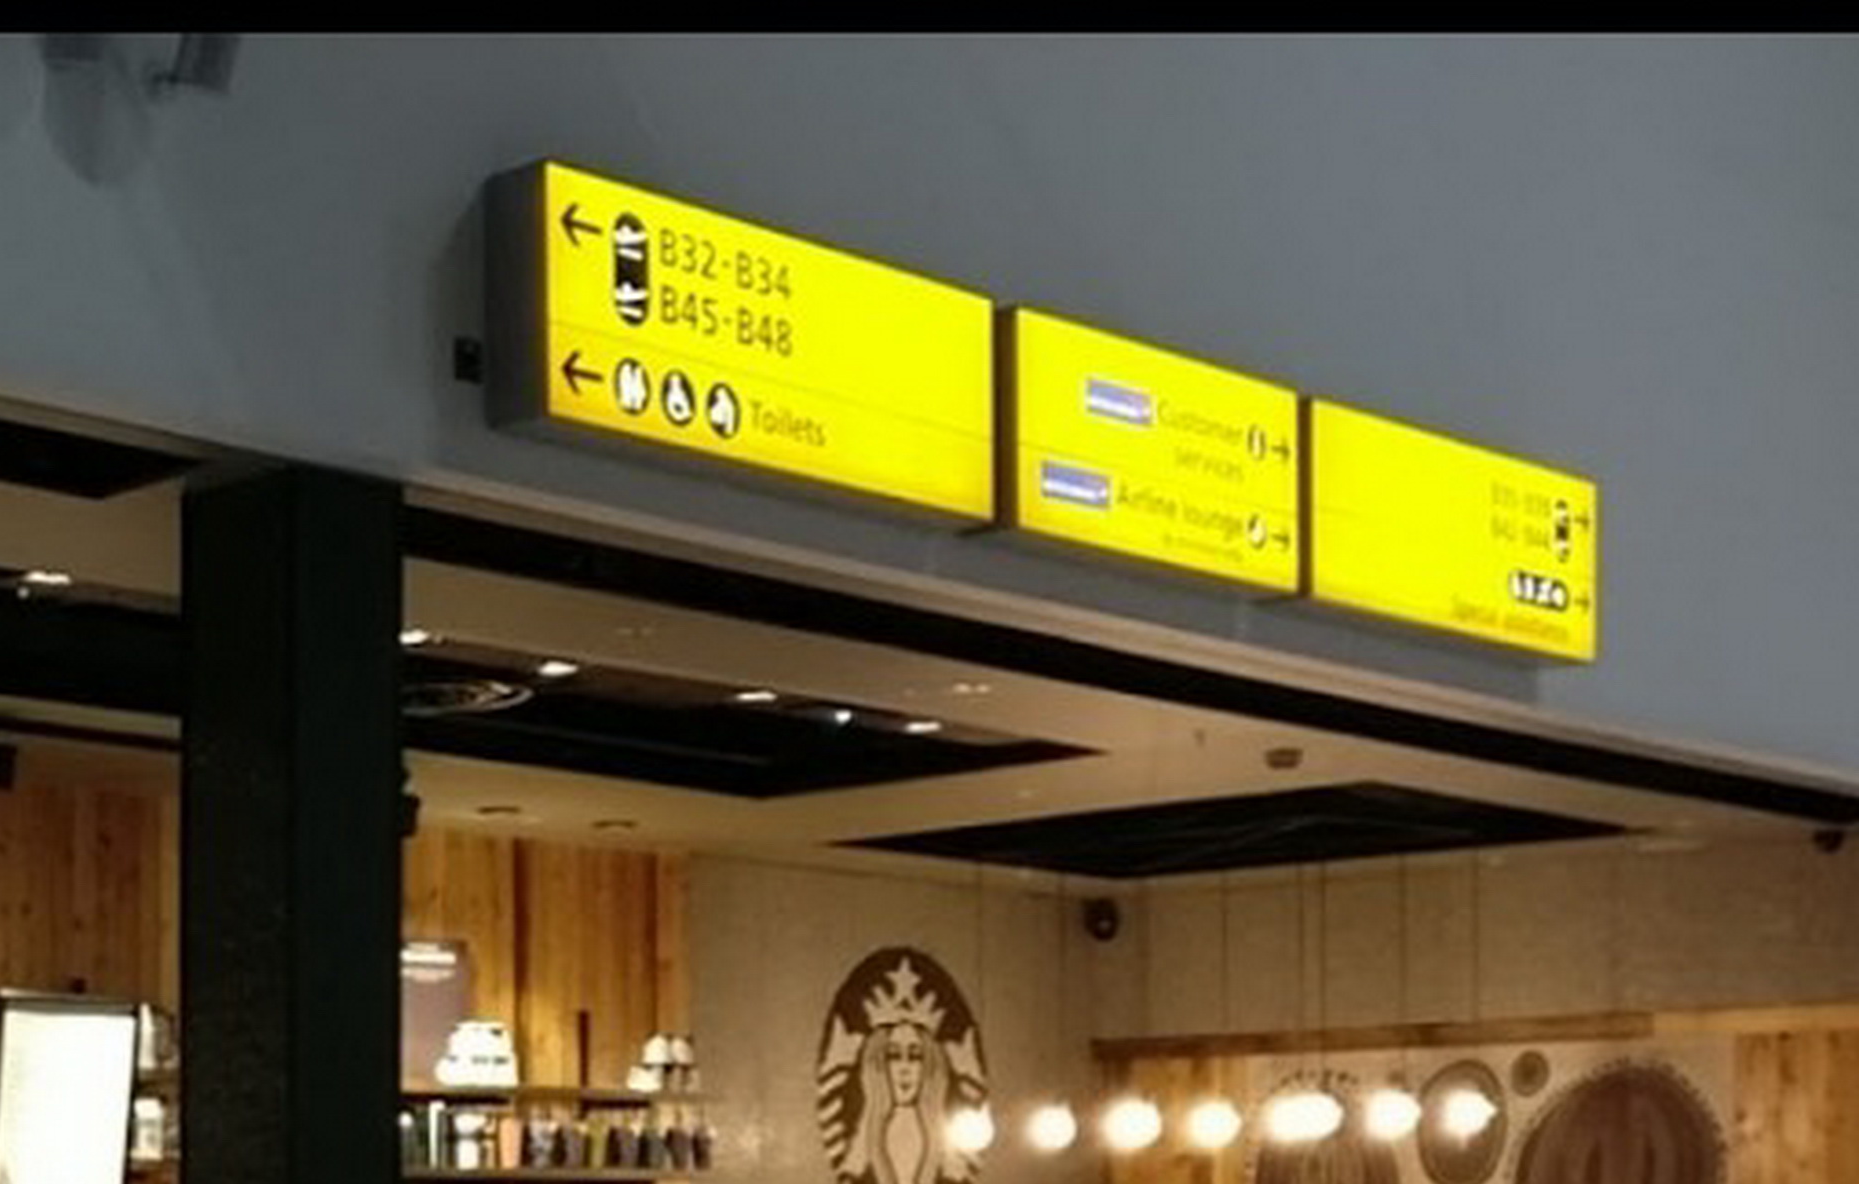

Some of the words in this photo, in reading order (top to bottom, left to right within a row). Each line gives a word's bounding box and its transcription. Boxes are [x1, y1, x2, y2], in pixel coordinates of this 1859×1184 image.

[660, 227, 791, 299] B32-B34
[660, 285, 794, 357] B45-B48
[750, 400, 826, 447] Toilets
